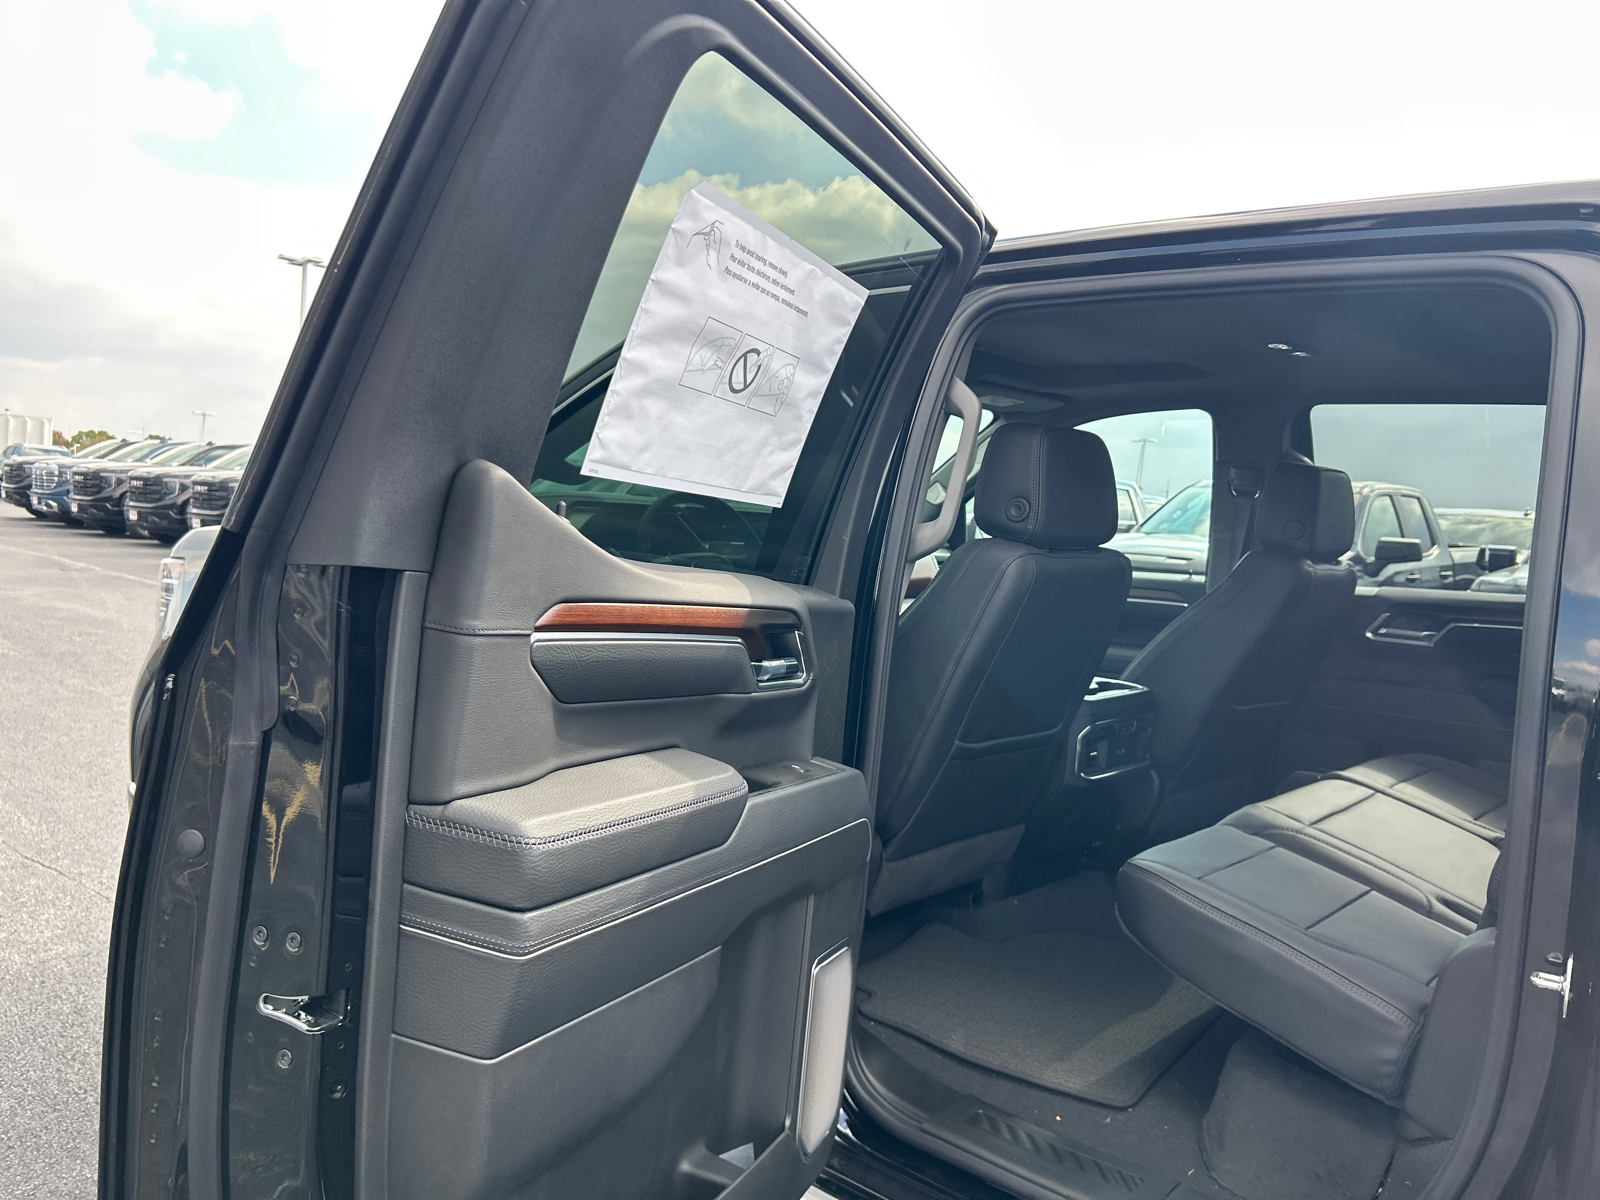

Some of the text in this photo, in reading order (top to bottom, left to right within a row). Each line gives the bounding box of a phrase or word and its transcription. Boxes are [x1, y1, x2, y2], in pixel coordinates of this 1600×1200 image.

[729, 253, 738, 264] Pour
[746, 263, 756, 274] toute
[735, 239, 740, 249] To
[739, 243, 747, 254] help
[746, 248, 756, 259] avoid
[755, 253, 768, 267] tearing,
[768, 261, 779, 272] remove
[724, 266, 732, 276] Para
